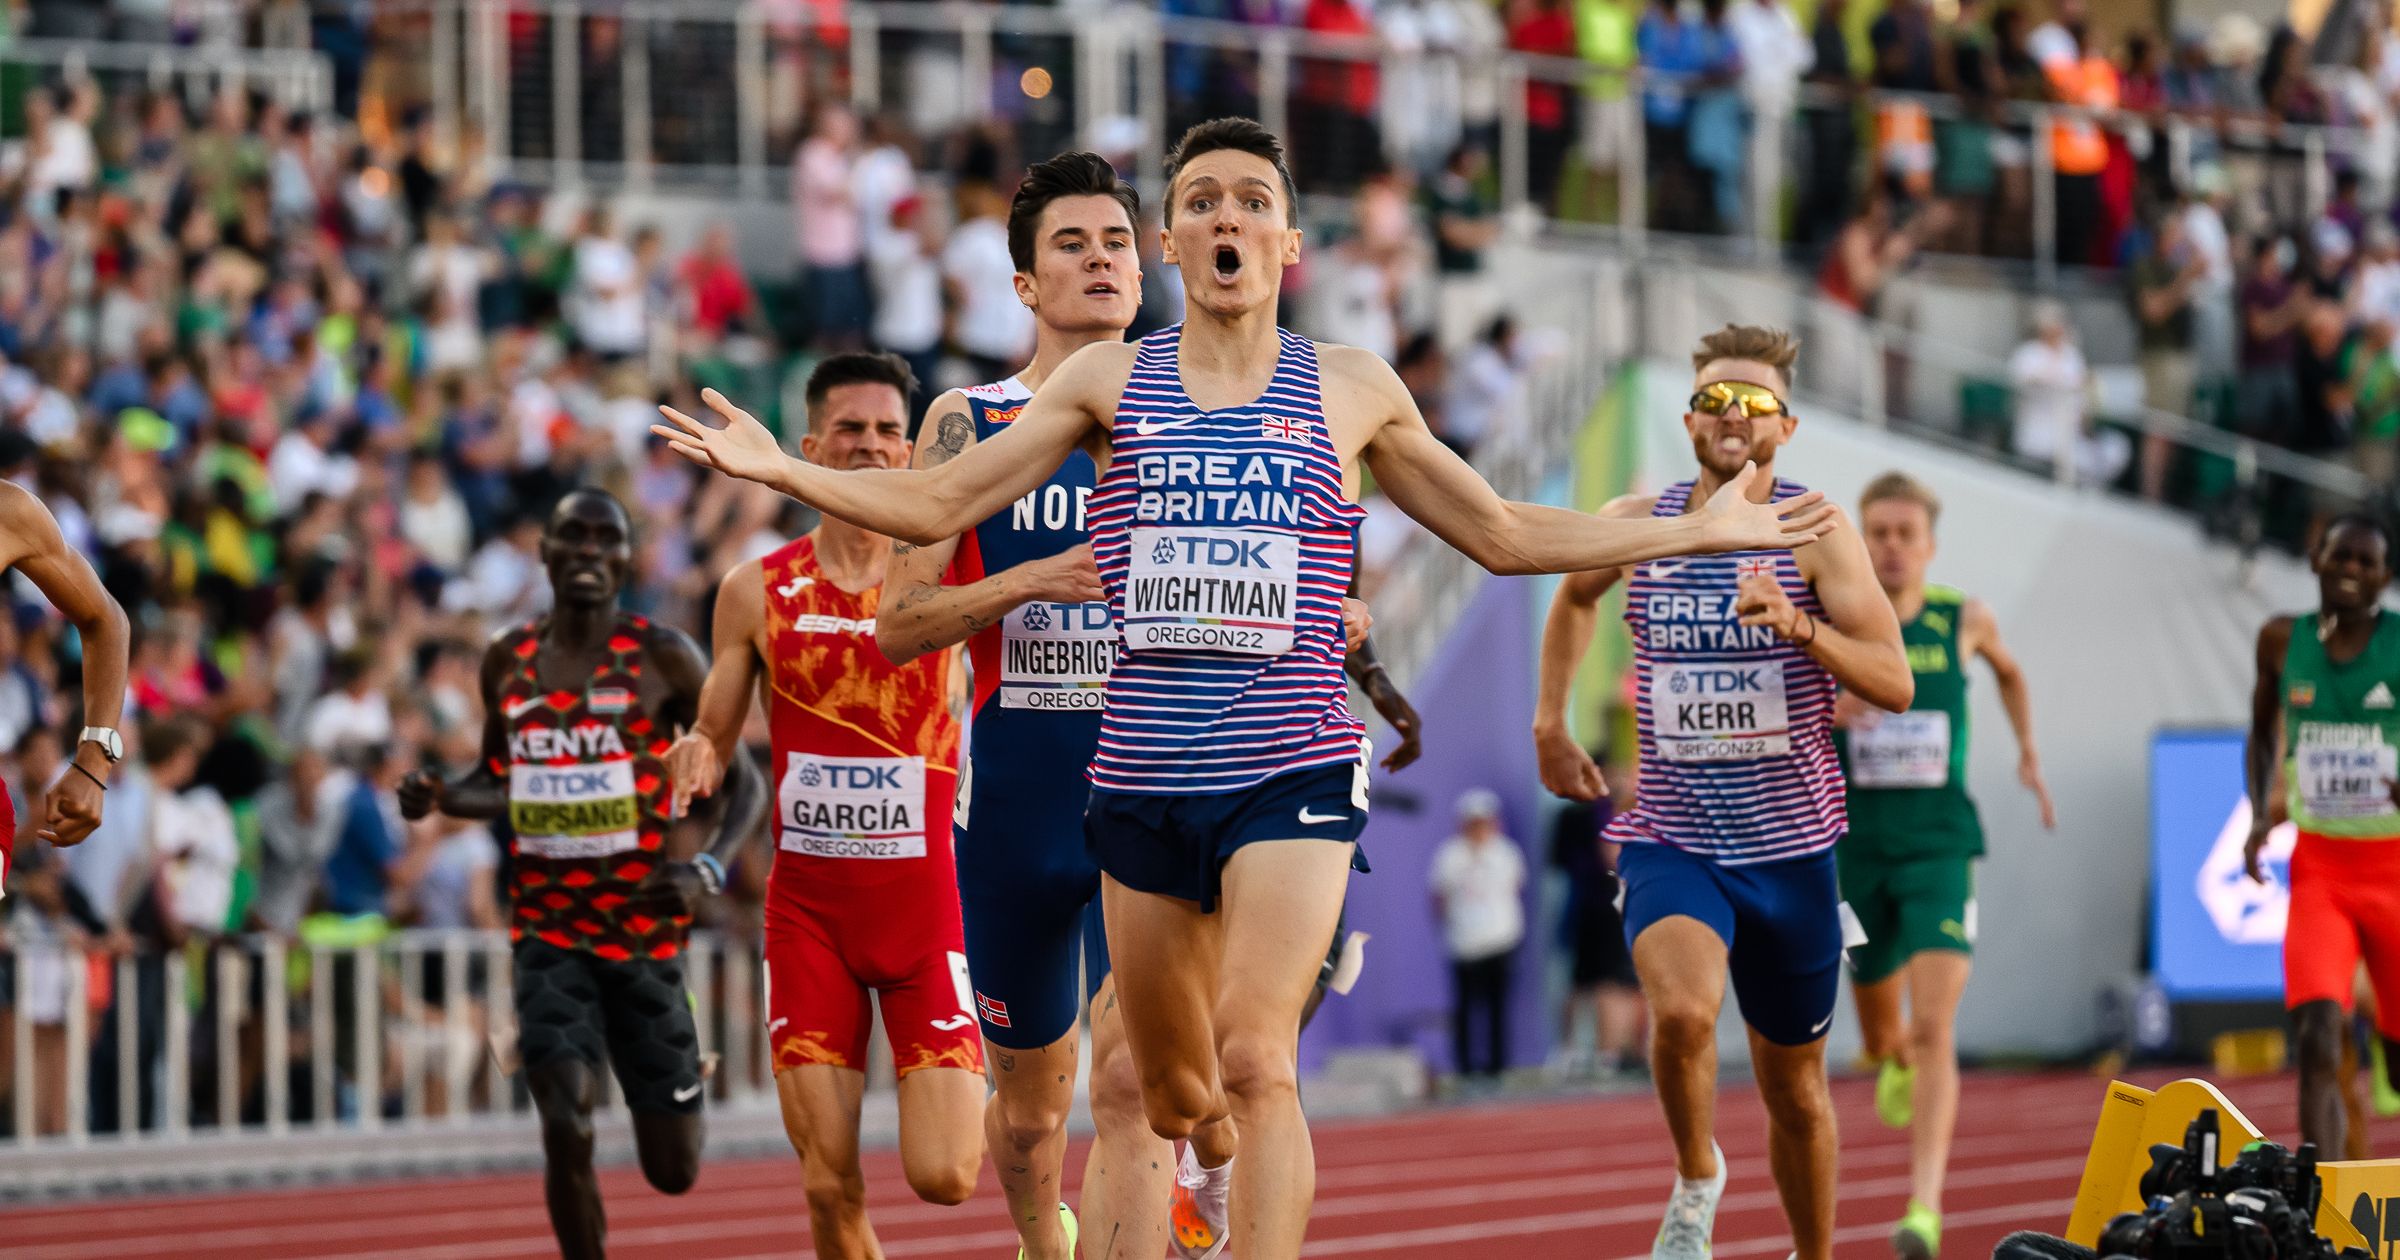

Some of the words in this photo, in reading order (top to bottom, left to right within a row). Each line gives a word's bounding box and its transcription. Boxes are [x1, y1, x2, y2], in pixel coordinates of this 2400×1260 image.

[1137, 455, 1303, 488] GREAT
[1136, 490, 1301, 526] BRITAIN
[1176, 536, 1273, 569] TDK
[1135, 575, 1286, 619] WIGHTMAN
[1146, 626, 1264, 649] OREGON22
[1649, 624, 1774, 650] BRITAIN
[1688, 670, 1762, 693] TDK
[1678, 702, 1756, 731] KERR
[508, 724, 627, 759] KENYA
[1676, 741, 1766, 757] OREGON22
[547, 771, 612, 795] TDK
[821, 764, 903, 790] TDK
[517, 799, 630, 831] KIPSANG
[793, 799, 911, 831] GARCÍA
[802, 837, 899, 856] OREGON22
